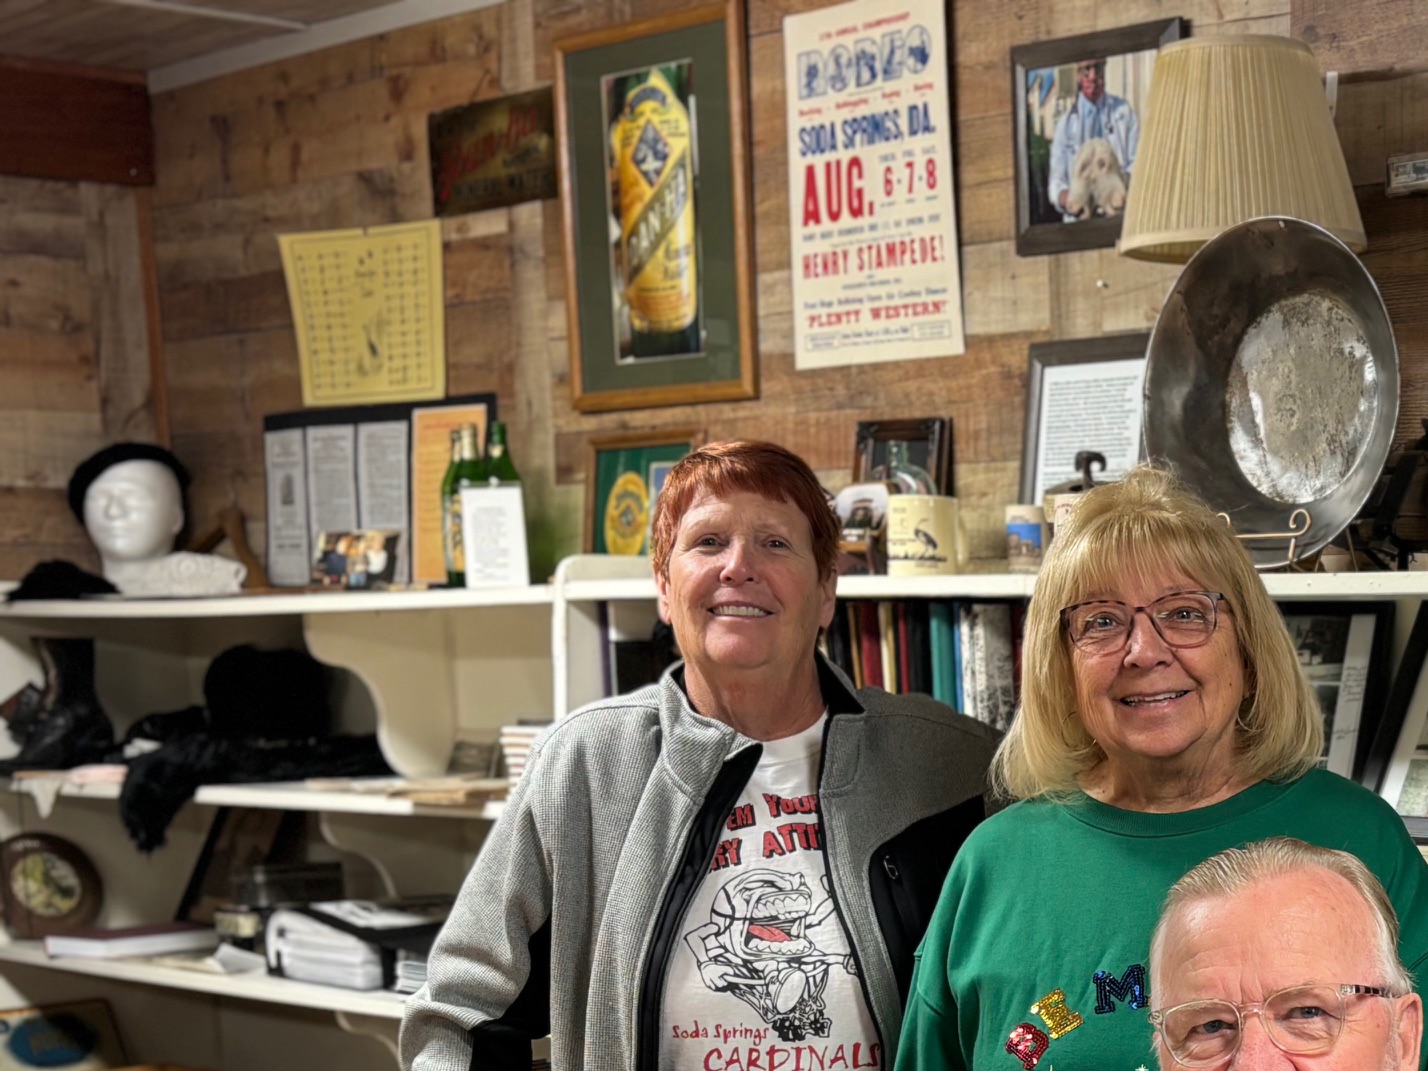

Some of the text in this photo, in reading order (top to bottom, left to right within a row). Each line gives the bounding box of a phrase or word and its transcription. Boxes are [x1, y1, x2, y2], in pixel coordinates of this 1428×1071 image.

[797, 24, 932, 100] RODEO
[799, 121, 838, 156] SODA
[842, 109, 904, 149] SPRINGS,
[803, 156, 874, 227] AUG.
[802, 249, 849, 280] HENRY
[857, 234, 945, 272] STAMPEDE!
[709, 823, 822, 873] RY ATTI
[672, 1019, 769, 1046] Soda Springs
